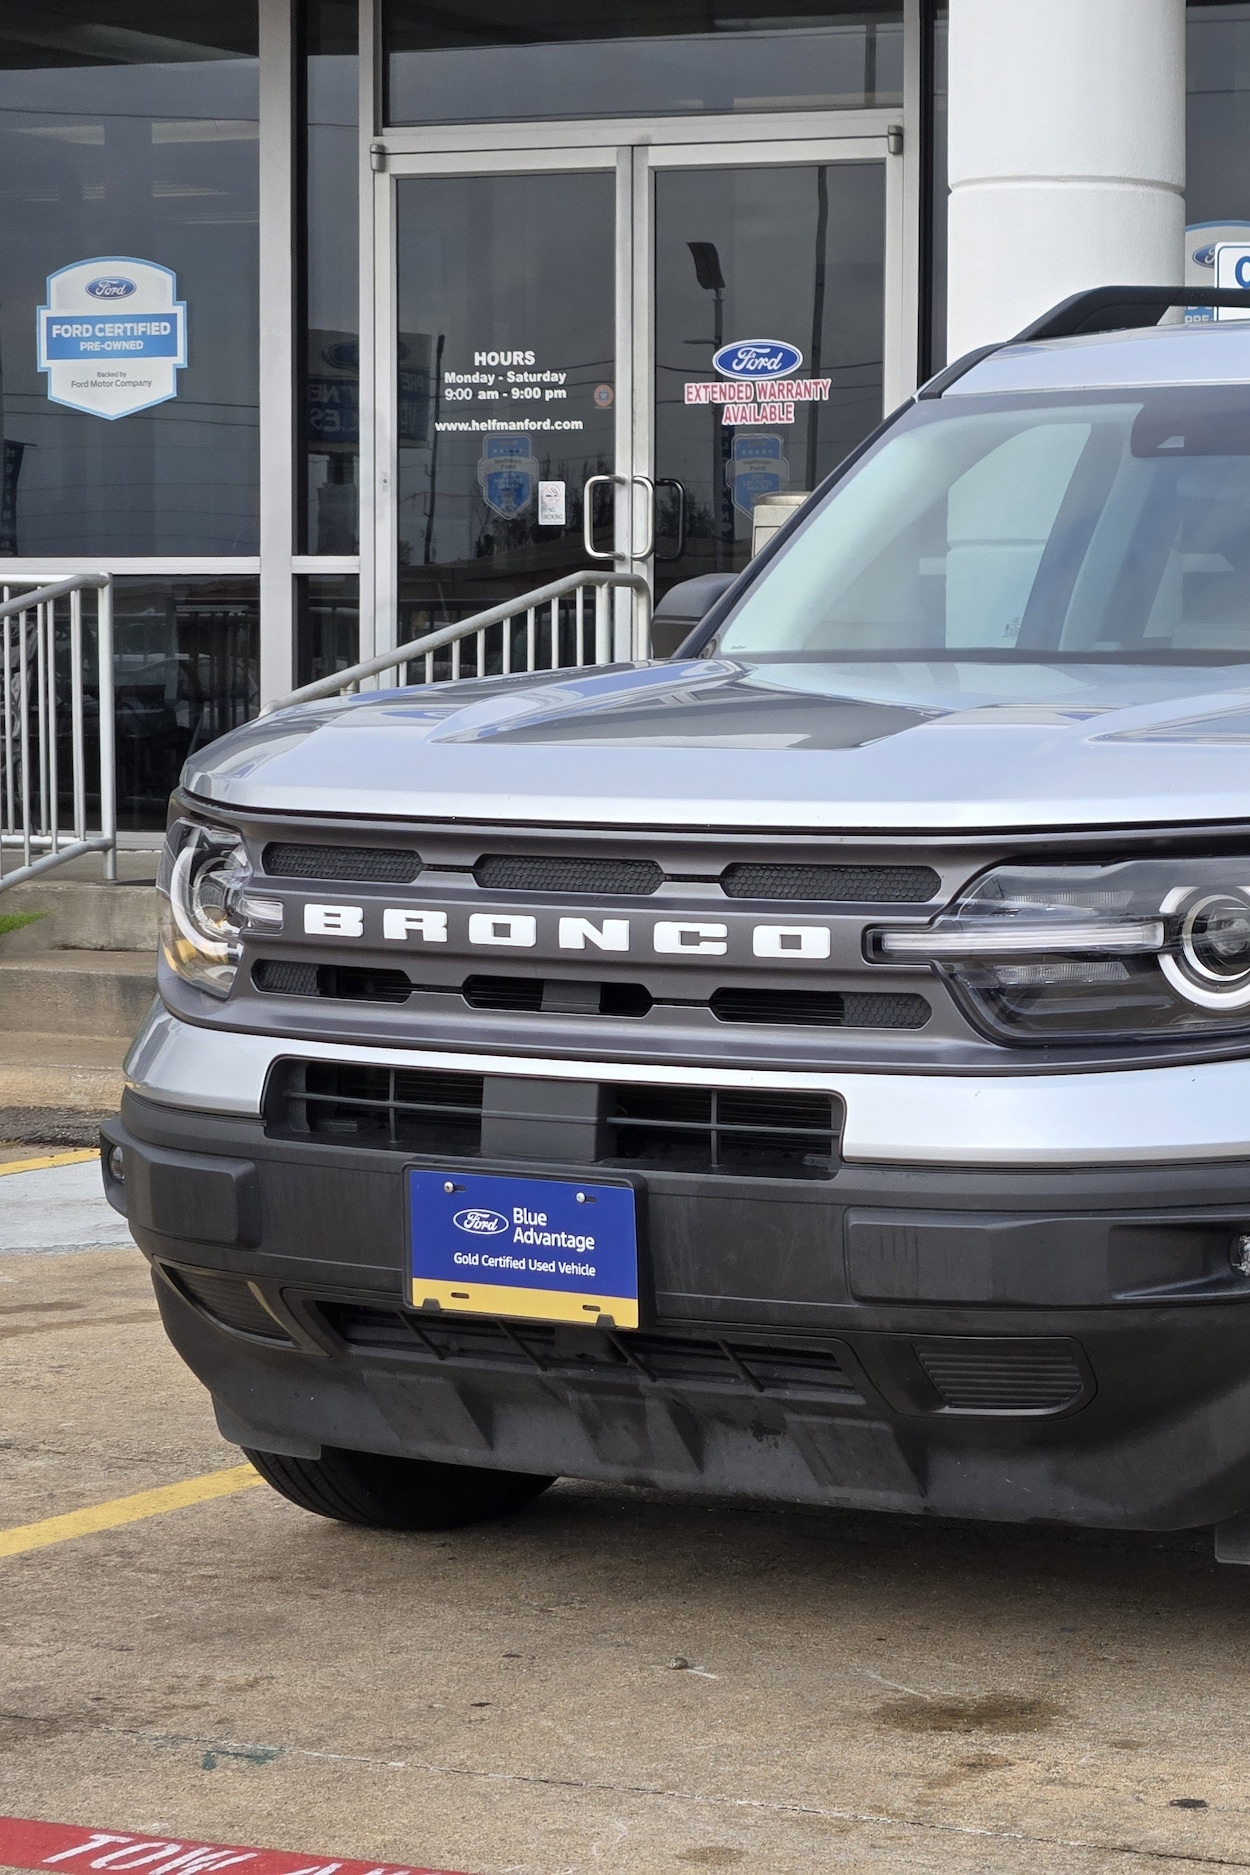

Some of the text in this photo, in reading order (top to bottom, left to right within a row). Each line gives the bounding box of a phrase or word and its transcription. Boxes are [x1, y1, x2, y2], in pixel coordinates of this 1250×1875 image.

[95, 279, 127, 297] Ford
[52, 321, 171, 338] FORD CERTIFIED
[80, 340, 144, 351] PRE-OWNED
[474, 351, 536, 366] HOURS
[732, 346, 784, 371] Ford
[71, 379, 153, 389] Ford Motor Company
[119, 371, 127, 379] by
[444, 371, 496, 386] Monday
[506, 370, 567, 385] Saturday
[445, 388, 473, 401] 9:00
[478, 389, 499, 400] am
[511, 387, 541, 400] 9:00
[545, 389, 567, 402] pm
[686, 379, 831, 403] EXTENDED WARRANTY
[723, 404, 794, 424] AVAILABLE
[435, 418, 584, 432] www.helfmanford.com
[303, 902, 831, 960] BRONCO
[463, 1211, 499, 1233] Ford
[512, 1207, 548, 1227] Blue
[513, 1227, 596, 1253] Advantage
[453, 1252, 596, 1277] Gold Certified Used Vehicle
[41, 1833, 259, 1875] TOW
